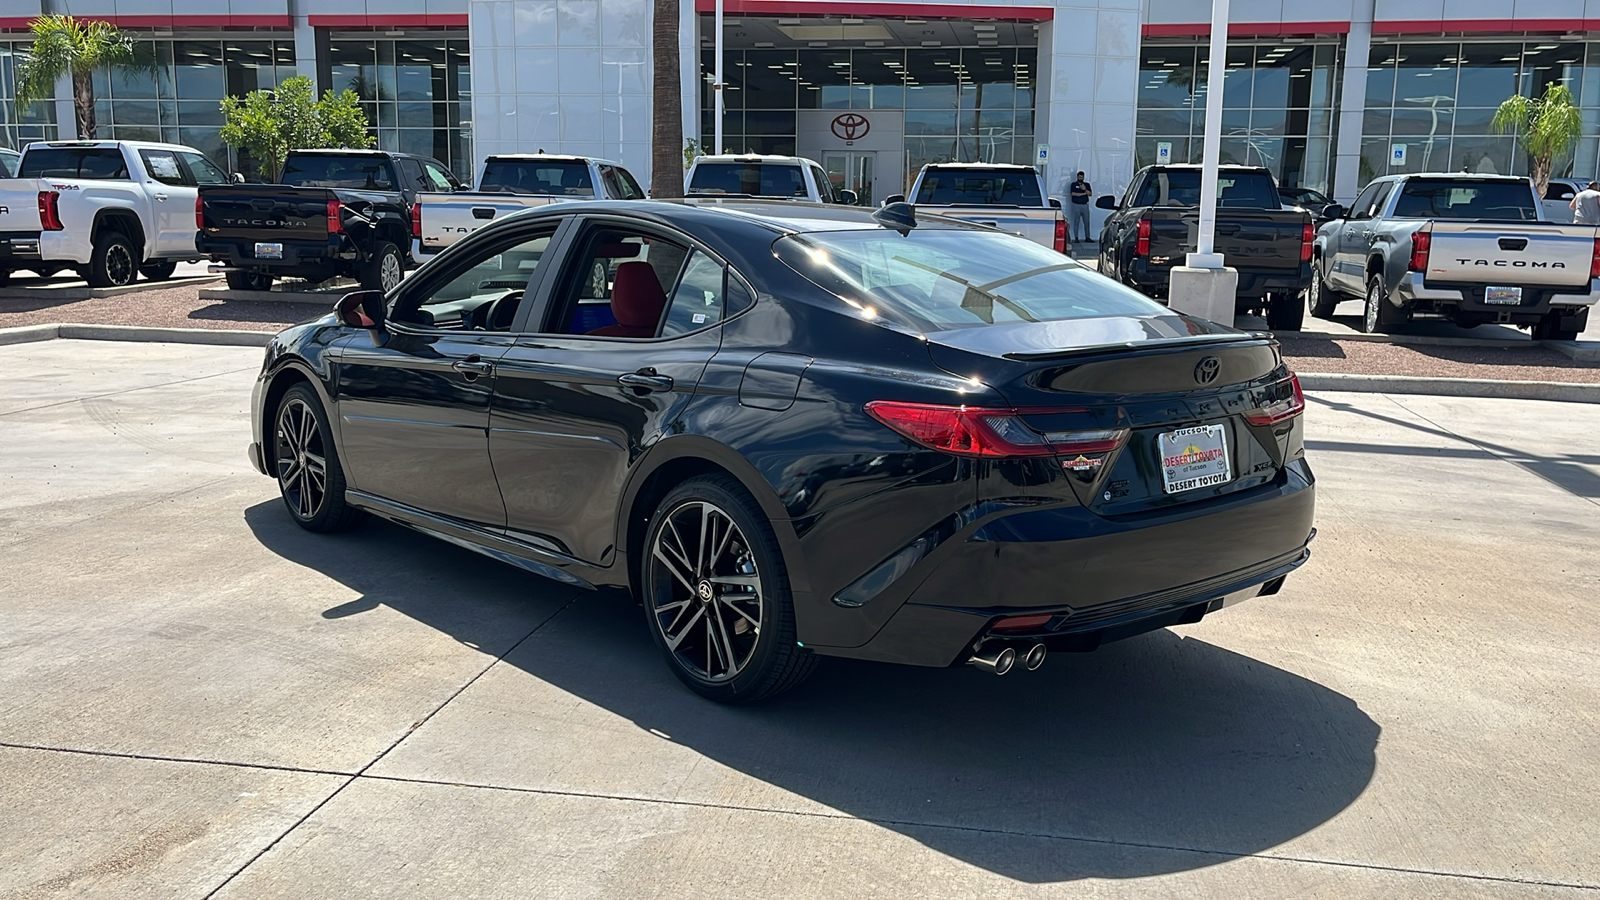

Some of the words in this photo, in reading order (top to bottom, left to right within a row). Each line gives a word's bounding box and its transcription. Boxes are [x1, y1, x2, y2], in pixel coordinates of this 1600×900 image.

[223, 218, 307, 227] TACOMA
[1456, 258, 1566, 269] TACOMA
[1176, 426, 1208, 437] TUCSON
[1165, 453, 1193, 468] DESERT
[1195, 448, 1224, 462] TOYOTA
[1189, 464, 1207, 472] Tucson
[1169, 480, 1197, 492] DESERT
[1199, 473, 1228, 486] TOYOTA
